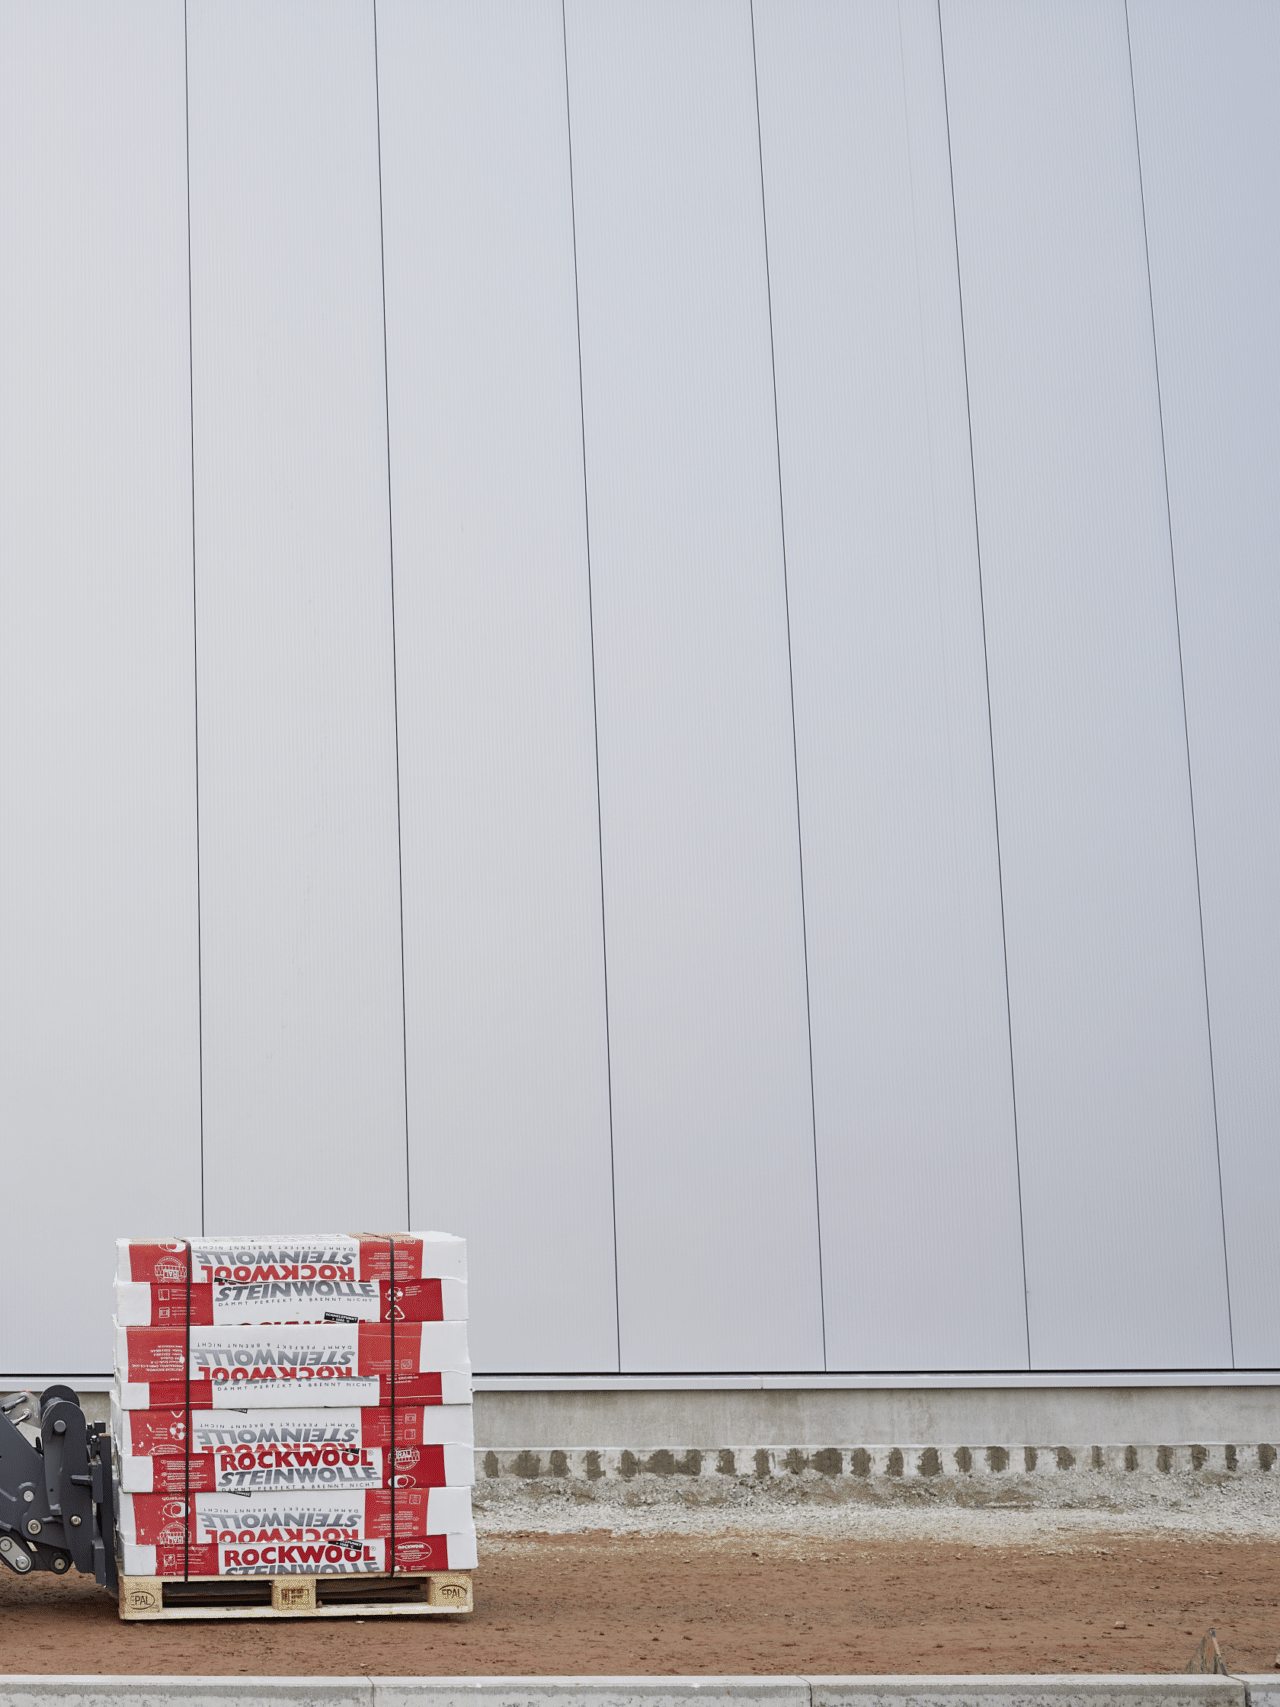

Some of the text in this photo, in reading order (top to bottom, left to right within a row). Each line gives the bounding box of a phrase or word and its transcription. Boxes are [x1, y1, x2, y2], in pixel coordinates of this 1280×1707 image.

[191, 1250, 357, 1265] STEINWOLLE
[201, 1265, 355, 1283] ROCKWOOL
[215, 1281, 379, 1302] STEINWOLLE
[190, 1349, 355, 1366] STEINWOLLE
[193, 1428, 359, 1444] STEINWOLLE
[221, 1450, 373, 1471] ROCKWOOL
[218, 1467, 381, 1487] STEINWOLLE
[196, 1512, 362, 1529] STEINWOLLE
[205, 1528, 359, 1543] ROCKWOOL
[225, 1546, 376, 1567] ROCKWOOL
